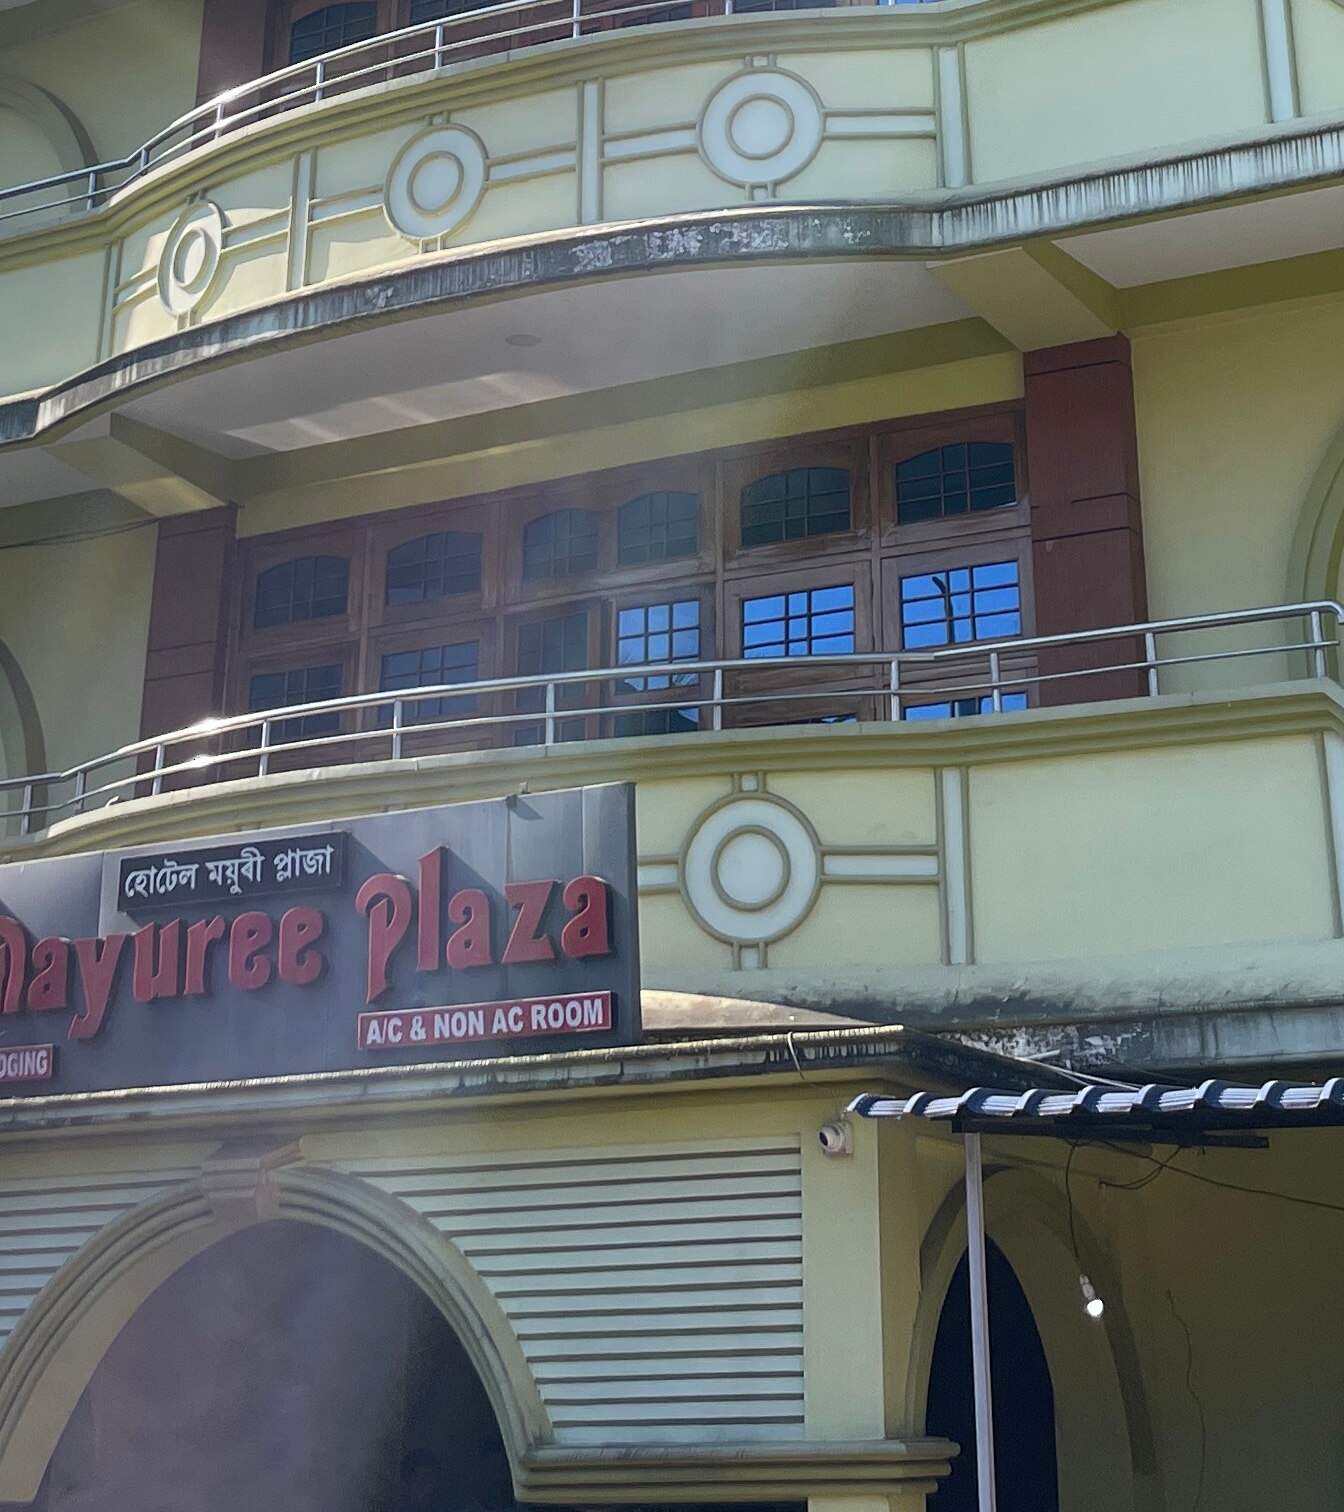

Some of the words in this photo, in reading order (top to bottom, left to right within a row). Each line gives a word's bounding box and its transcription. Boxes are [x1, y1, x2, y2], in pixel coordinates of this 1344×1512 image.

[125, 859, 199, 897] হোটেল
[274, 844, 335, 882] প্লাজা
[356, 846, 610, 1004] Plaza
[366, 1016, 403, 1045] A/C
[410, 1015, 426, 1041] &
[434, 1010, 484, 1038] NON
[492, 1006, 523, 1034] AC
[531, 998, 603, 1030] ROOM
